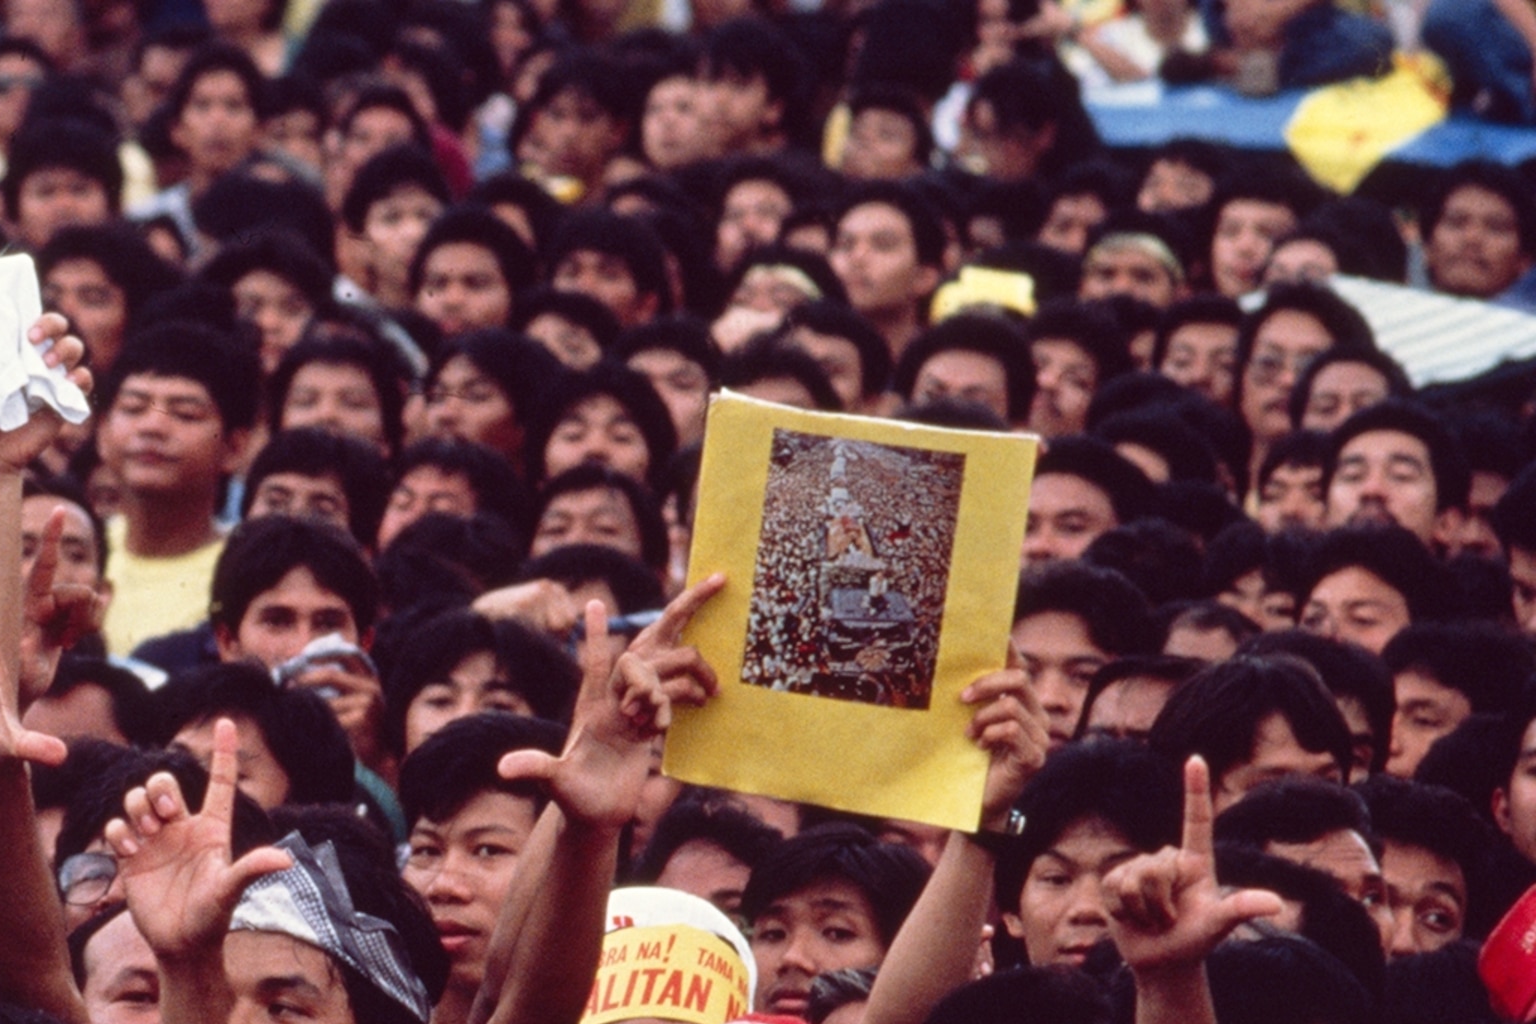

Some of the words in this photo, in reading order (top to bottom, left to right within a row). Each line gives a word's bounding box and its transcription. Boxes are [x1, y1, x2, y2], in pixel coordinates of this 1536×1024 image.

[598, 945, 628, 968] BRA
[636, 934, 676, 963] NA!
[698, 948, 733, 982] TAMA
[585, 968, 713, 1016] ALITAN
